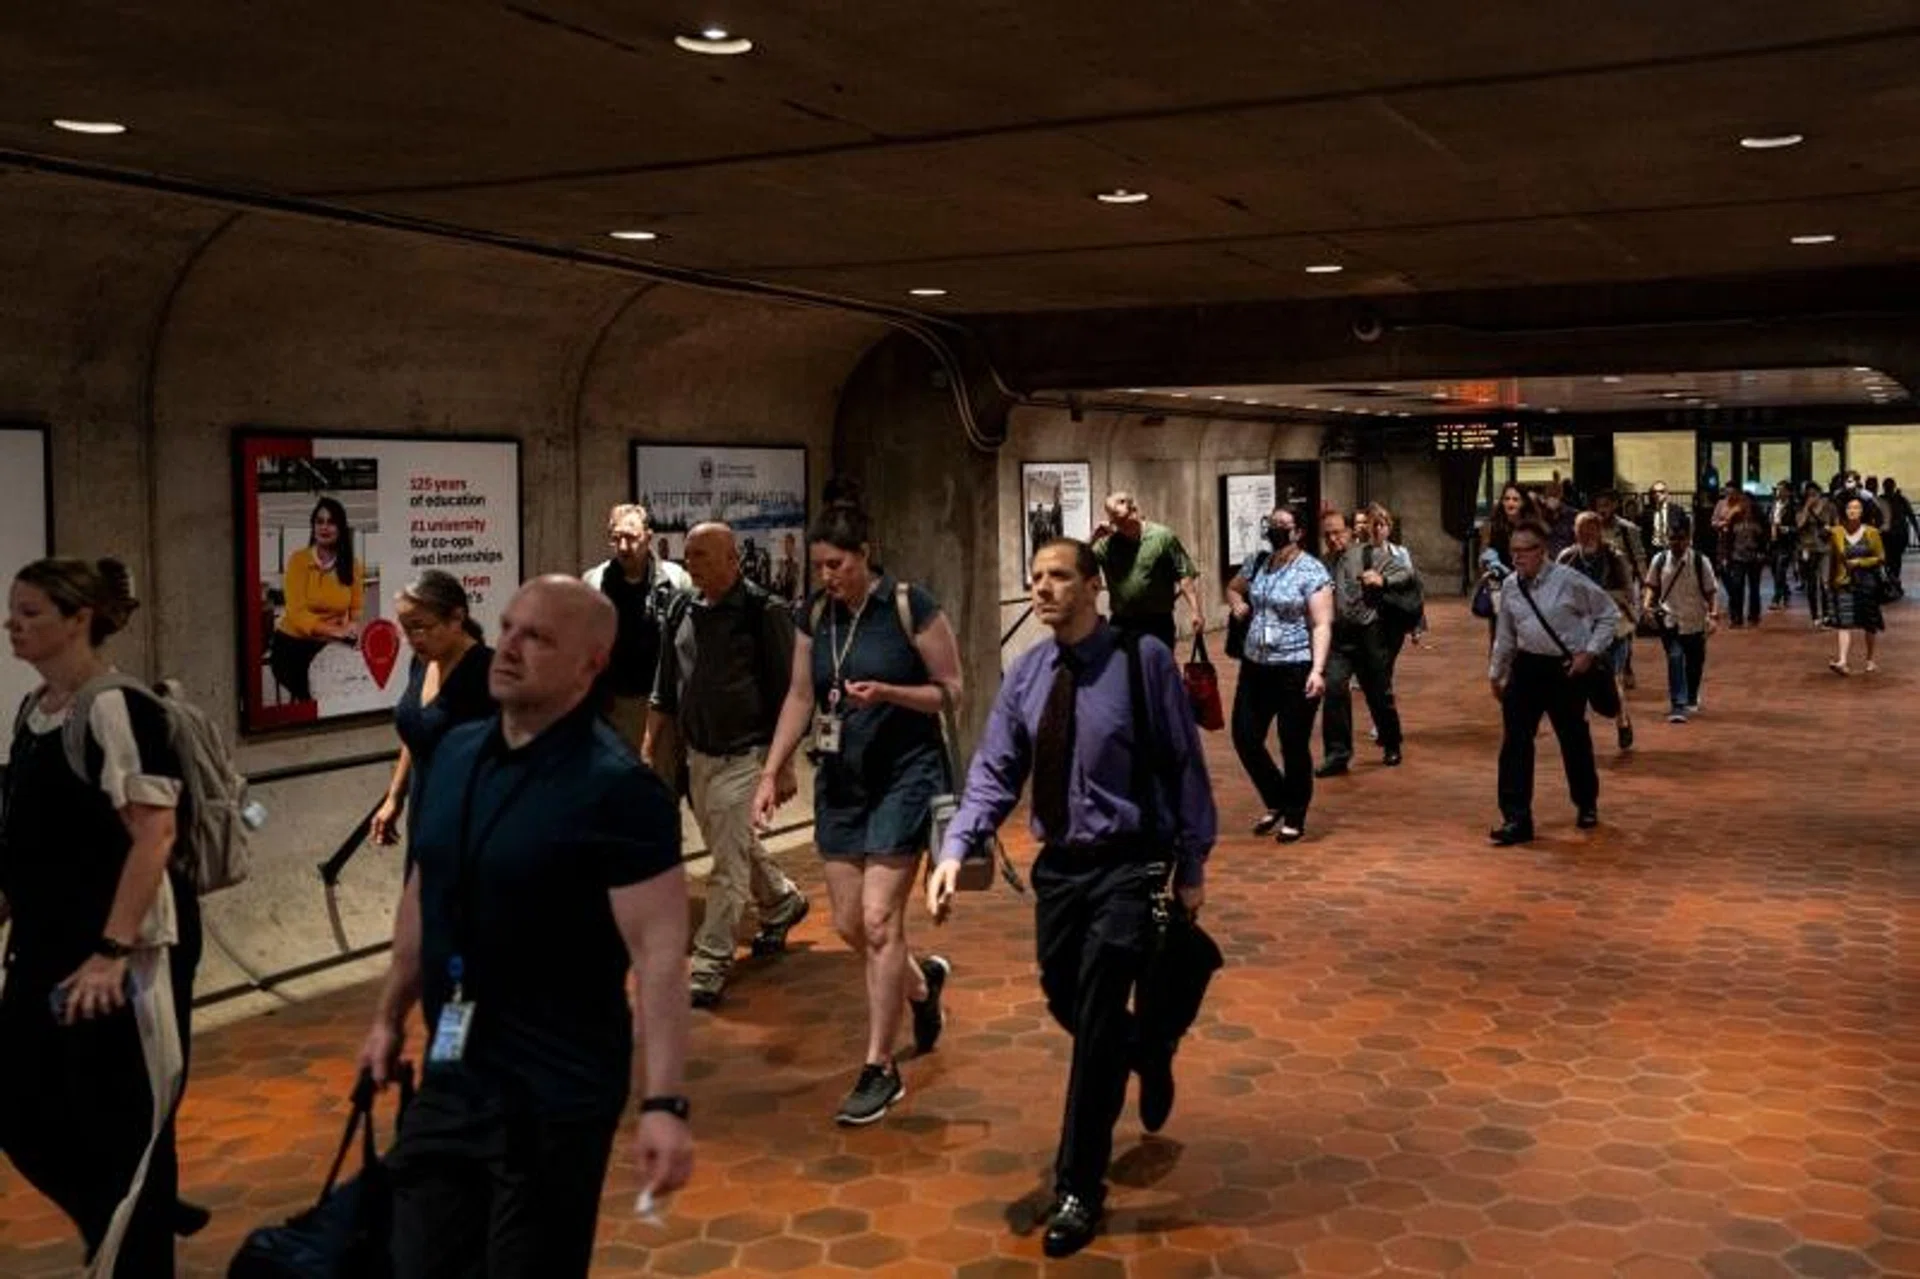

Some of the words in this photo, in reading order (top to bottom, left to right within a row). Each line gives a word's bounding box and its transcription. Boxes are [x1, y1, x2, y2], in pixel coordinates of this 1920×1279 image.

[410, 477, 432, 491] 125
[434, 479, 467, 492] years
[410, 495, 423, 507] of
[425, 494, 486, 507] education
[427, 517, 486, 534] university
[410, 536, 429, 548] for
[431, 537, 474, 549] co-ops
[411, 553, 436, 566] and
[437, 548, 503, 564] internships
[463, 576, 491, 587] from
